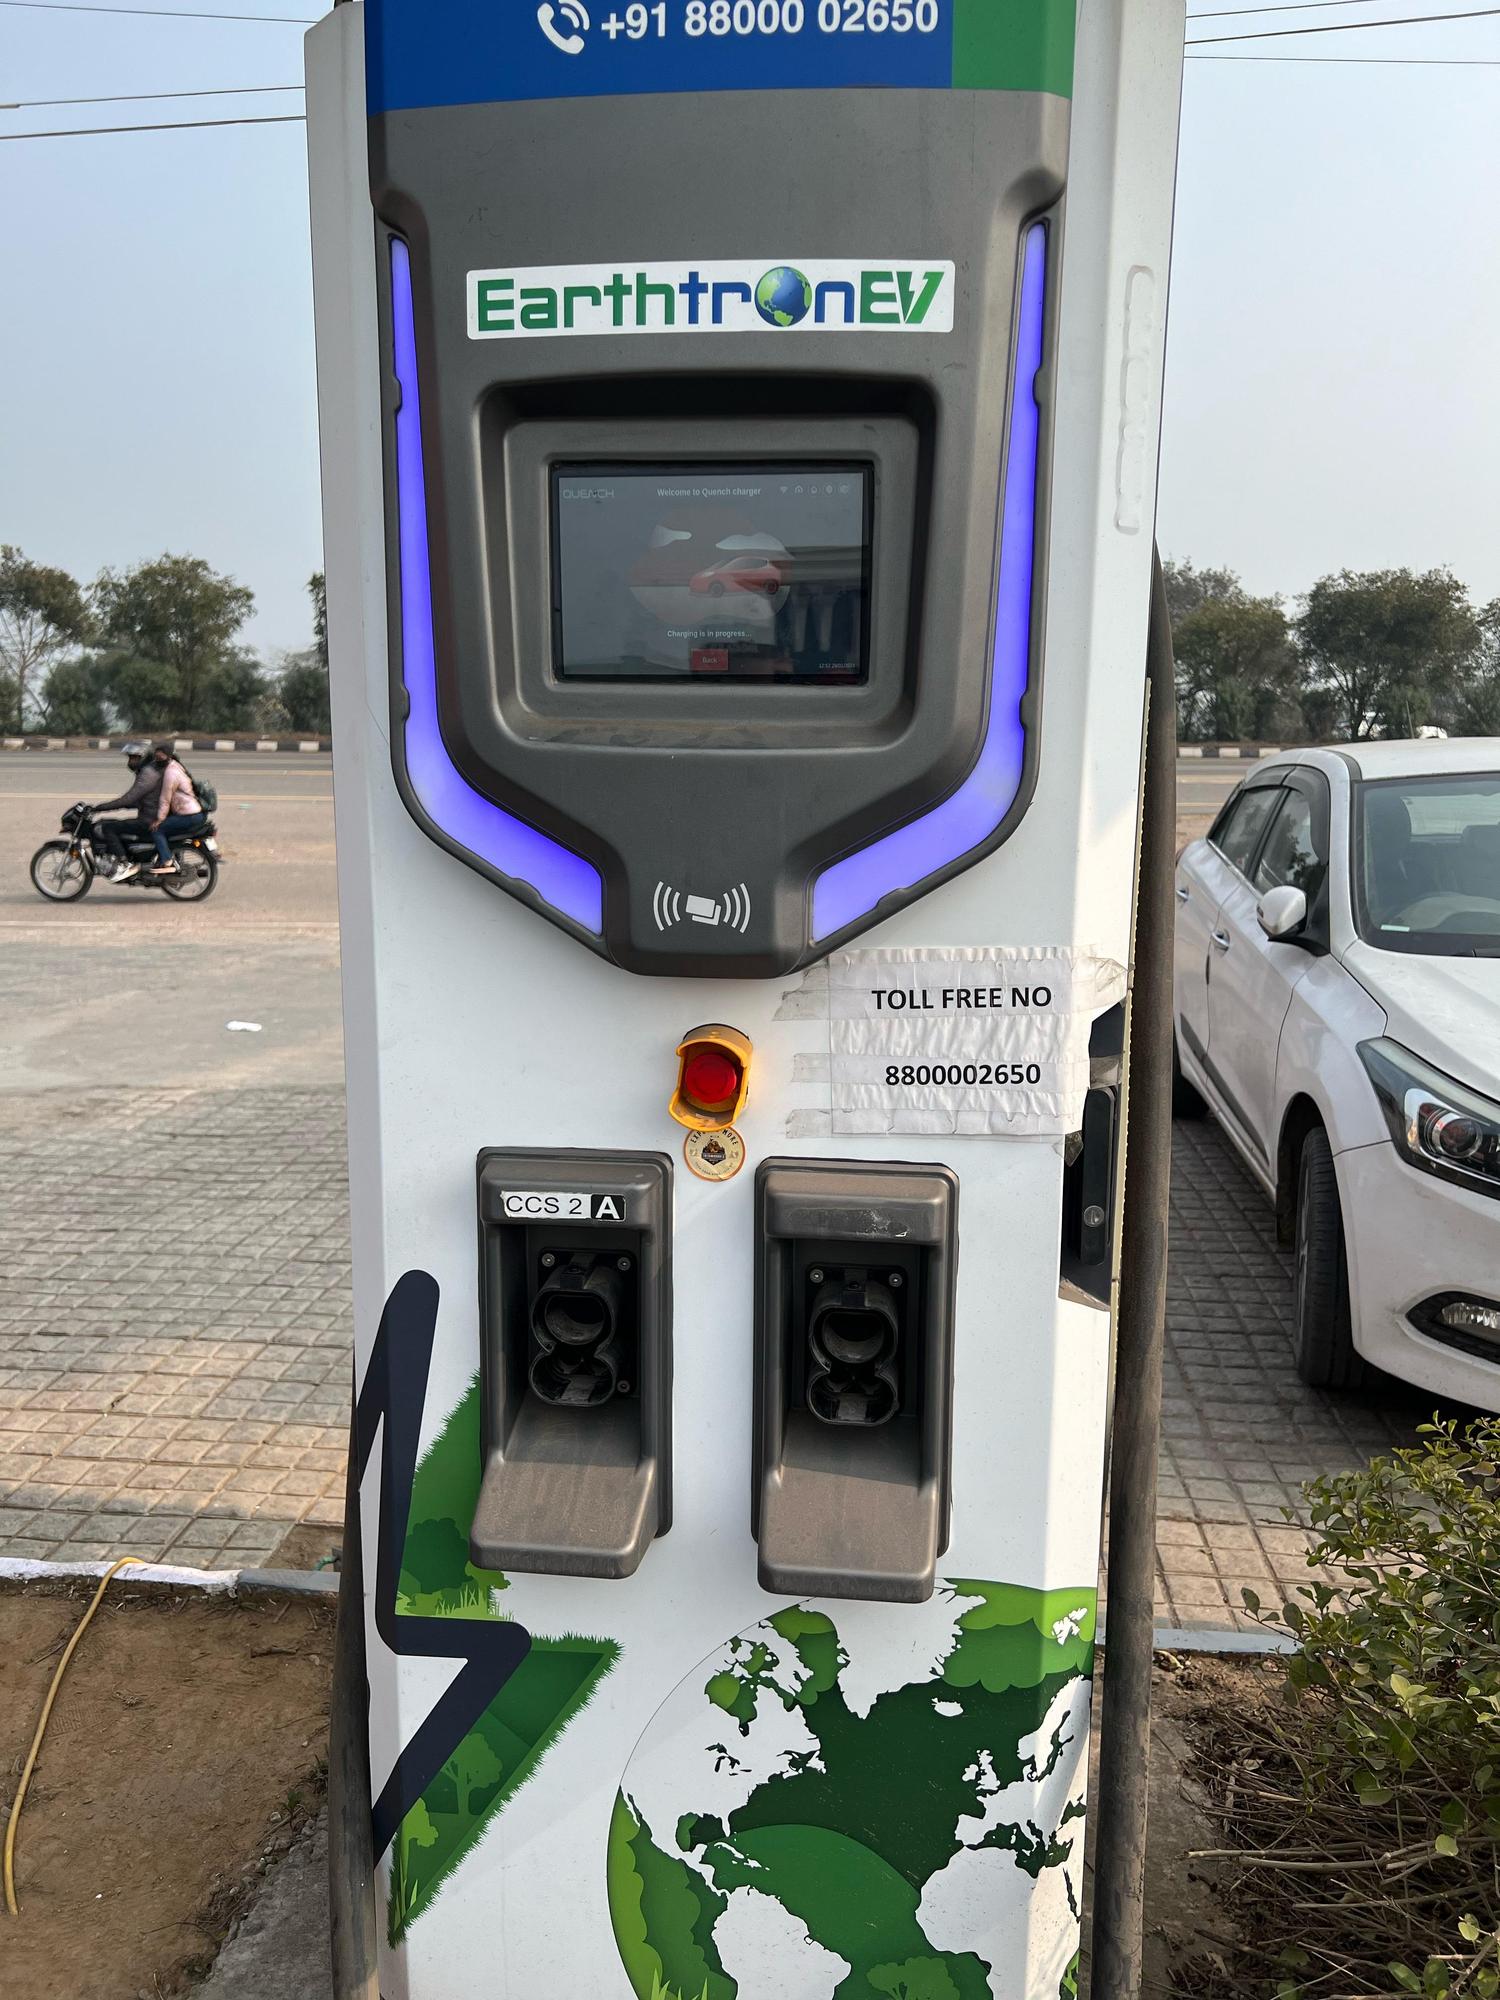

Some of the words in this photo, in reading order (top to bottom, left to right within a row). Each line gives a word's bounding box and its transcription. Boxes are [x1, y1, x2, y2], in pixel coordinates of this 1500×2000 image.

[601, 2, 666, 39] +91
[684, 0, 803, 37] 88000
[817, 0, 939, 33] 02650
[562, 488, 616, 500] QUENCH
[656, 487, 691, 497] Welcome
[692, 488, 700, 496] to
[701, 487, 731, 498] Quench
[732, 487, 762, 497] charger
[666, 630, 698, 639] Charging
[699, 630, 706, 638] is
[702, 656, 719, 664] Back
[871, 989, 934, 1010] TOLL
[941, 988, 1003, 1009] FREE
[1011, 986, 1053, 1008] NO
[885, 1063, 1042, 1086] 8800002650
[506, 1195, 560, 1215] CCS
[568, 1197, 583, 1215] 2
[595, 1195, 621, 1220] A
